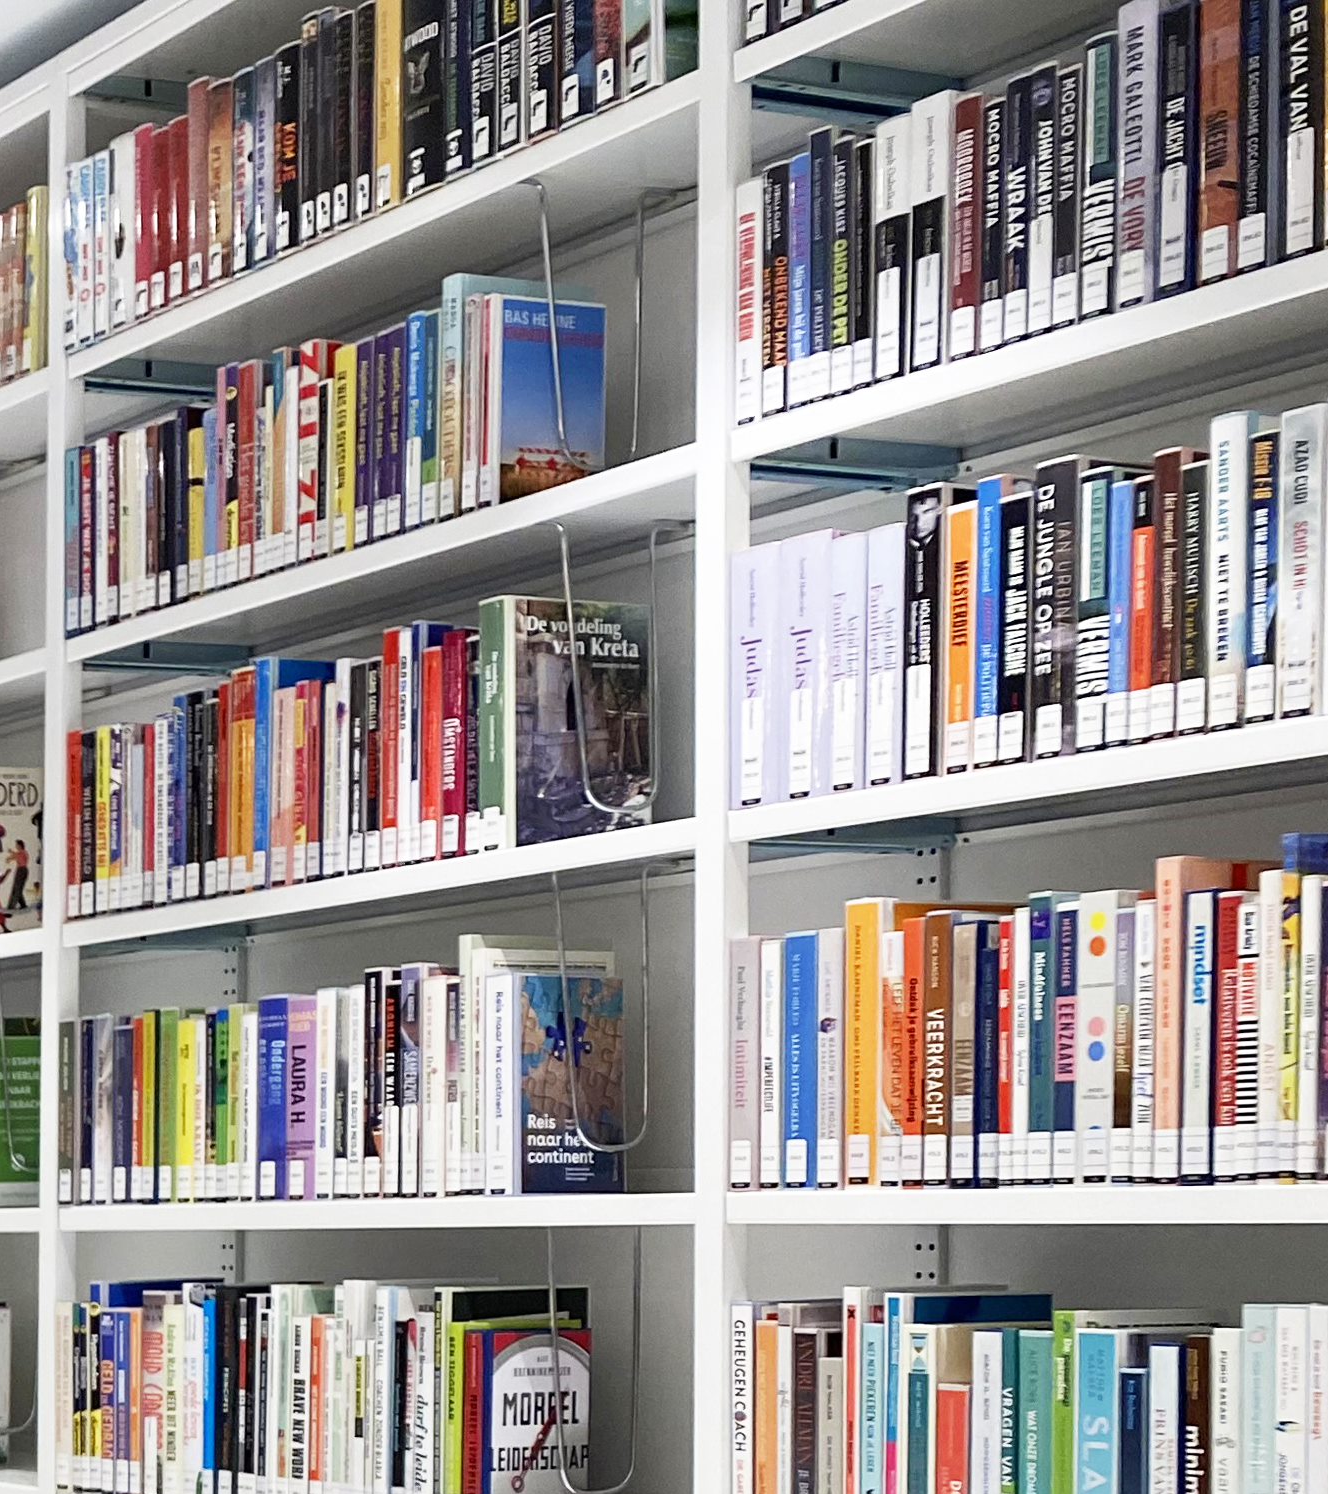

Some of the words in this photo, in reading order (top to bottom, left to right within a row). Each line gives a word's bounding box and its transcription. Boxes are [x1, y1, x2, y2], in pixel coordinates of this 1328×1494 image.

[1290, 5, 1310, 38] DE
[538, 25, 553, 64] DAVID
[1125, 26, 1145, 76] MARK
[1290, 40, 1309, 83] VAL
[481, 54, 494, 92] DAVID
[1059, 79, 1076, 136] MOCRO
[1124, 82, 1144, 164] GALEOTTI
[1167, 97, 1186, 118] DE
[1290, 84, 1309, 131] VAN
[986, 109, 1001, 165] MOCRO
[1037, 121, 1053, 160] JOHN
[1166, 121, 1185, 160] JACHT
[1037, 161, 1053, 194] VAN
[1059, 141, 1076, 201] MAFFIA
[1123, 176, 1145, 199] DE
[986, 169, 1001, 229] MAFFIA
[1007, 166, 1027, 253] WRAAK
[833, 240, 849, 292] ONDER
[774, 256, 788, 328] ONBEKEND
[833, 296, 849, 318] DE
[504, 309, 530, 326] BAS
[833, 323, 849, 346] PET
[227, 422, 240, 479] Mediation
[1217, 440, 1230, 493] SANDER
[1294, 440, 1310, 472] AZAD
[1034, 484, 1056, 512] DE
[1186, 492, 1201, 532] HARRY
[1055, 521, 1072, 552] IAN
[1217, 500, 1230, 543] AARTS
[1294, 521, 1310, 560] SCHOT
[1034, 519, 1055, 599] JUNGLE
[1186, 538, 1201, 594] MULISCH
[1217, 554, 1230, 582] NIET
[951, 560, 969, 648] MEESTERDIEF
[1006, 589, 1027, 620] JACK
[1217, 589, 1230, 605] TE
[526, 615, 548, 632] De
[550, 617, 622, 640] vodeling
[1035, 604, 1054, 635] OP
[1217, 610, 1230, 661] BREKEN
[552, 640, 586, 656] van
[592, 637, 640, 659] Kreta
[740, 636, 763, 698] Judas
[790, 626, 813, 689] Judas
[1004, 622, 1027, 677] FALCONE
[1033, 640, 1053, 677] ZEE
[1079, 615, 1110, 699] VERMIS
[442, 718, 462, 791] OMSTANDERS
[1190, 926, 1211, 1005] mindset
[495, 992, 505, 1013] Reis
[1034, 951, 1047, 1020] Mindfulness
[495, 1017, 504, 1042] naar
[891, 1012, 903, 1033] HET
[1057, 1003, 1076, 1075] EENZAAM
[270, 1040, 287, 1105] Ondergang
[289, 1044, 306, 1105] LAURA
[495, 1047, 504, 1063] het
[734, 1039, 750, 1109] Intimiteit
[890, 1036, 903, 1075] LEVEN
[925, 1008, 945, 1126] VEERKRACHT
[494, 1068, 504, 1119] continent
[890, 1077, 903, 1099] DAT
[526, 1114, 557, 1129] Reis
[526, 1132, 563, 1147] naar
[565, 1132, 586, 1148] he
[526, 1148, 595, 1165] continent
[101, 1360, 115, 1393] GELD
[733, 1320, 747, 1397] GEHEUGEN
[292, 1379, 305, 1413] BRAVE
[415, 1394, 429, 1433] durf
[865, 1379, 877, 1422] PIEKEREN
[292, 1418, 304, 1443] NEW
[1001, 1387, 1014, 1448] VRAGEN
[1026, 1410, 1038, 1431] WAT
[1154, 1408, 1169, 1460] PRINS
[415, 1435, 426, 1449] te
[1026, 1433, 1038, 1460] ONZE
[414, 1452, 427, 1492] leide
[1001, 1456, 1014, 1486] VAN
